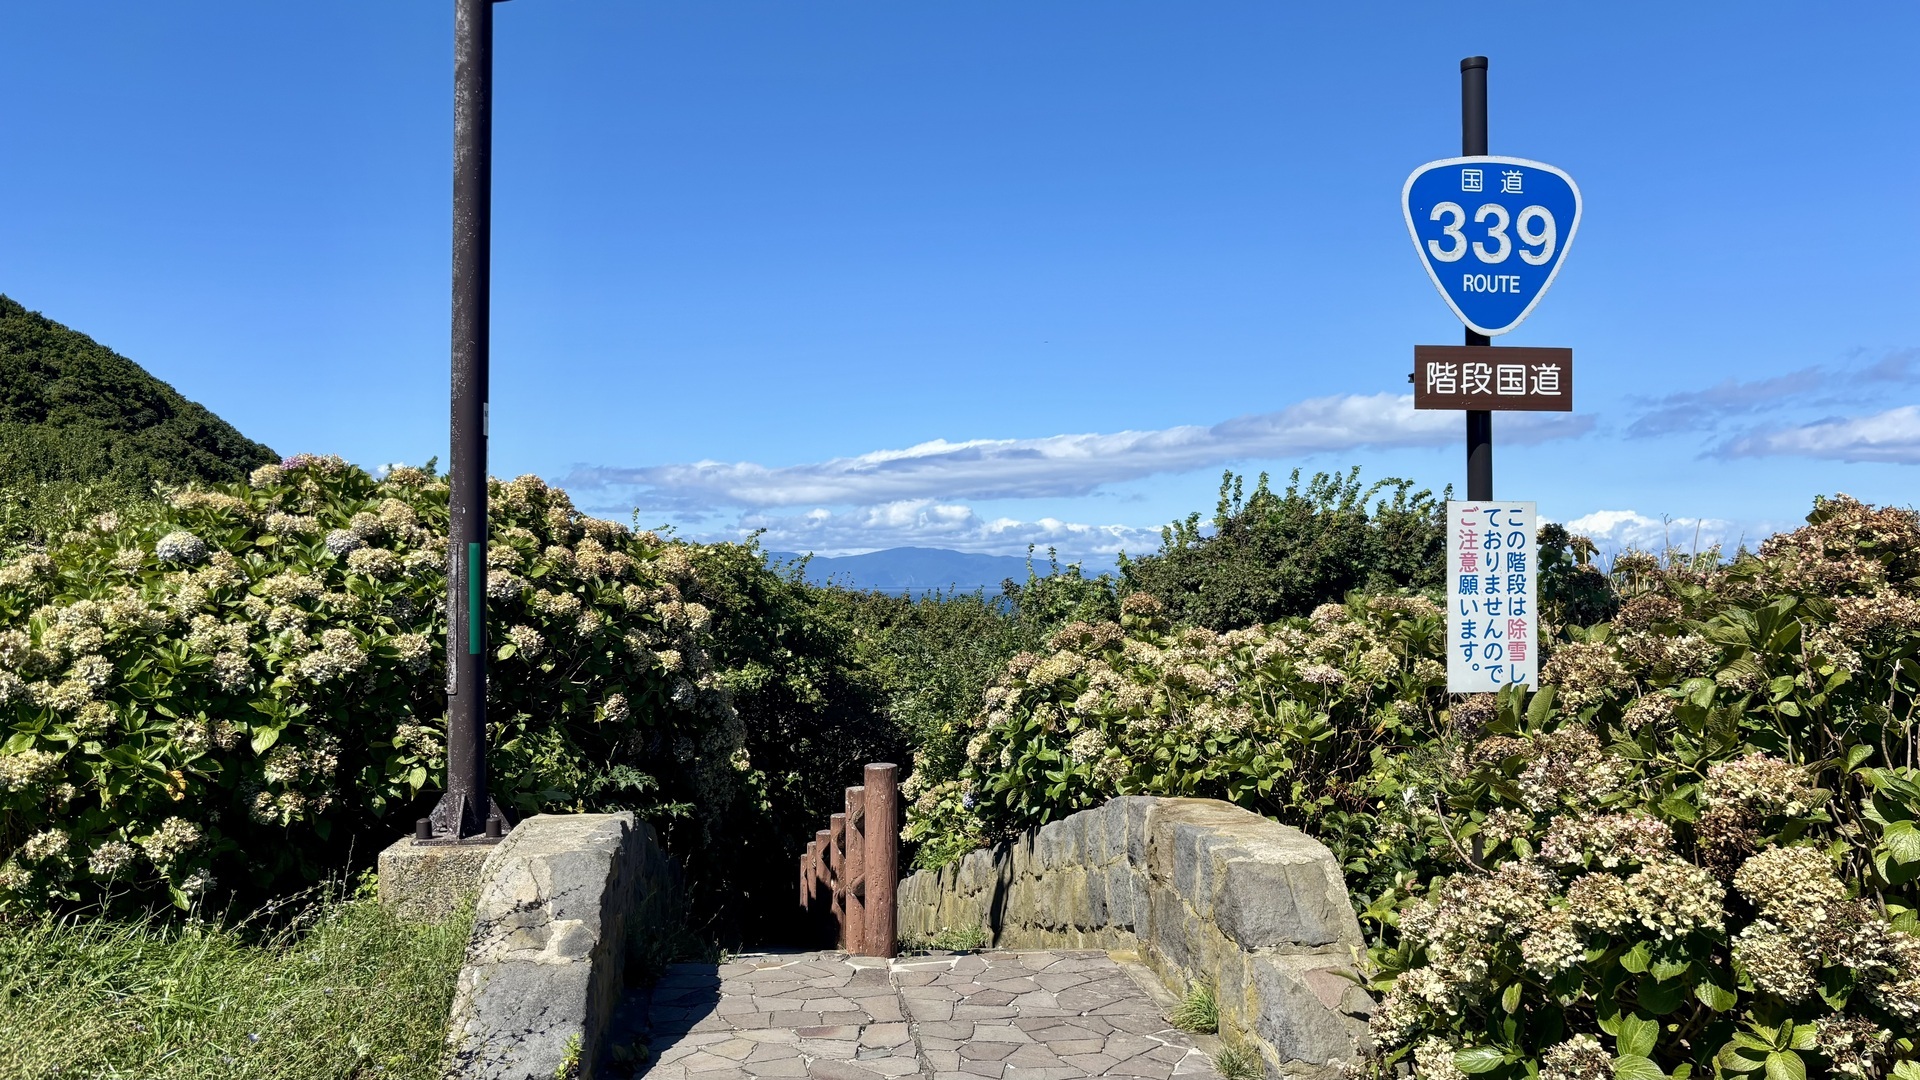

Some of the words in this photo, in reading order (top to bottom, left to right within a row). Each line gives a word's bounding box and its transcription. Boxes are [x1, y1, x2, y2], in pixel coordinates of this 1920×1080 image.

[1461, 168, 1524, 194] 国道
[1427, 201, 1557, 266] 339
[1463, 273, 1521, 293] ROUTE
[1426, 361, 1562, 396] 階段国道
[1458, 506, 1480, 672] ご注意願います。
[1483, 508, 1504, 684] ておりませんので
[1506, 507, 1528, 684] この階段は除雪し
